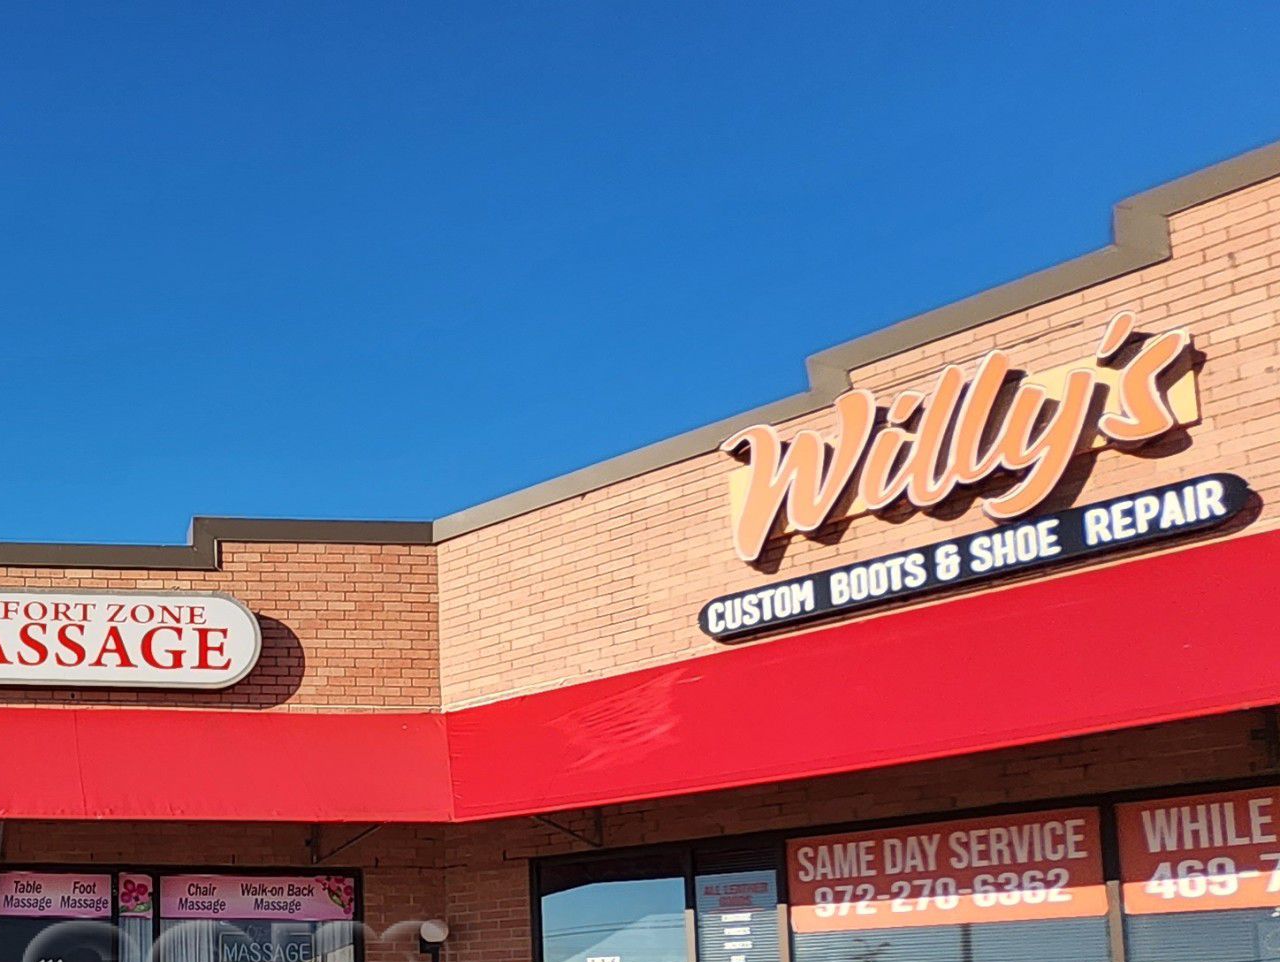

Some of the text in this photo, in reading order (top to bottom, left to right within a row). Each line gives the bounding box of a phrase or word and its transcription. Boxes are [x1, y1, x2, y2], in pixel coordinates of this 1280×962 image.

[720, 310, 1190, 562] Willy's
[707, 478, 1228, 635] CUSTOM BOOTS & SHOE REPAIR
[106, 603, 208, 625] ZONE
[1141, 797, 1278, 854] WHILE
[797, 818, 1089, 883] SAME DAY SERVICE
[13, 879, 43, 894] Table
[72, 881, 97, 895] Foot
[187, 882, 217, 897] Chair
[240, 882, 315, 897] Walk-on Back
[813, 867, 1074, 919] 972-270-6362
[3, 895, 53, 911] Massage
[60, 895, 109, 912] Massage
[177, 897, 227, 913] Massage
[253, 898, 302, 914] Massage
[222, 942, 312, 962] MASSAGE
